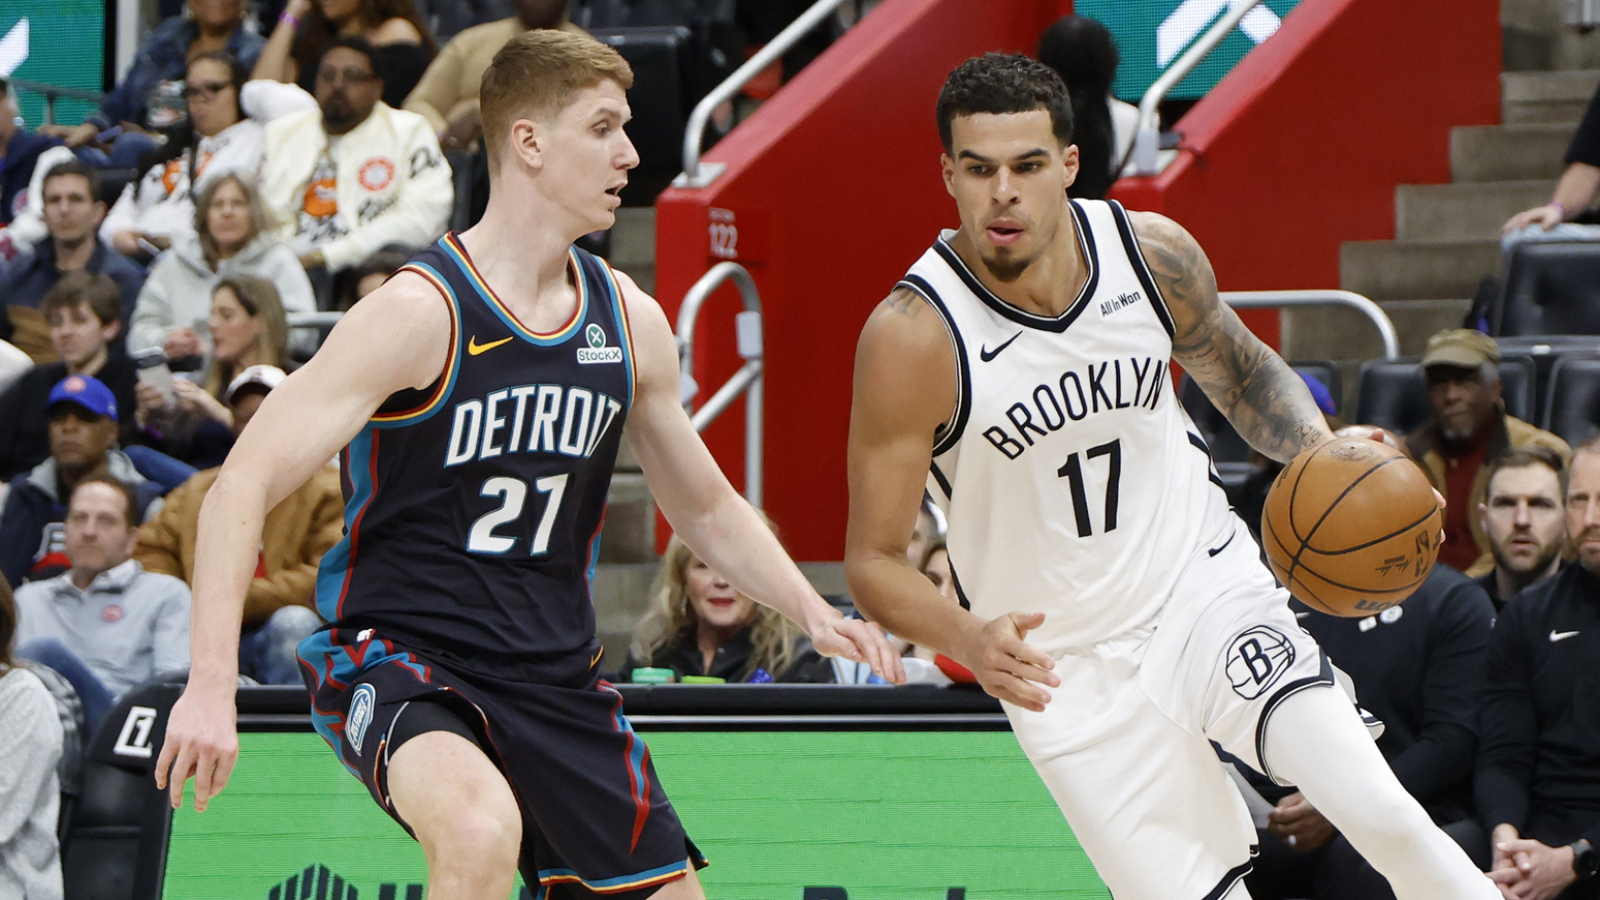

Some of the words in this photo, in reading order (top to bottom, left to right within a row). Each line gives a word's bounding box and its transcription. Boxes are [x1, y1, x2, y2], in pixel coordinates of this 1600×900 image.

[1100, 301, 1113, 317] All
[1111, 299, 1121, 312] In
[1117, 291, 1141, 307] Won
[578, 349, 621, 361] StockX
[443, 383, 623, 469] DETROIT
[982, 357, 1168, 460] BROOKLYN
[466, 473, 570, 556] 21
[1057, 438, 1122, 538] 17
[1239, 638, 1273, 686] B
